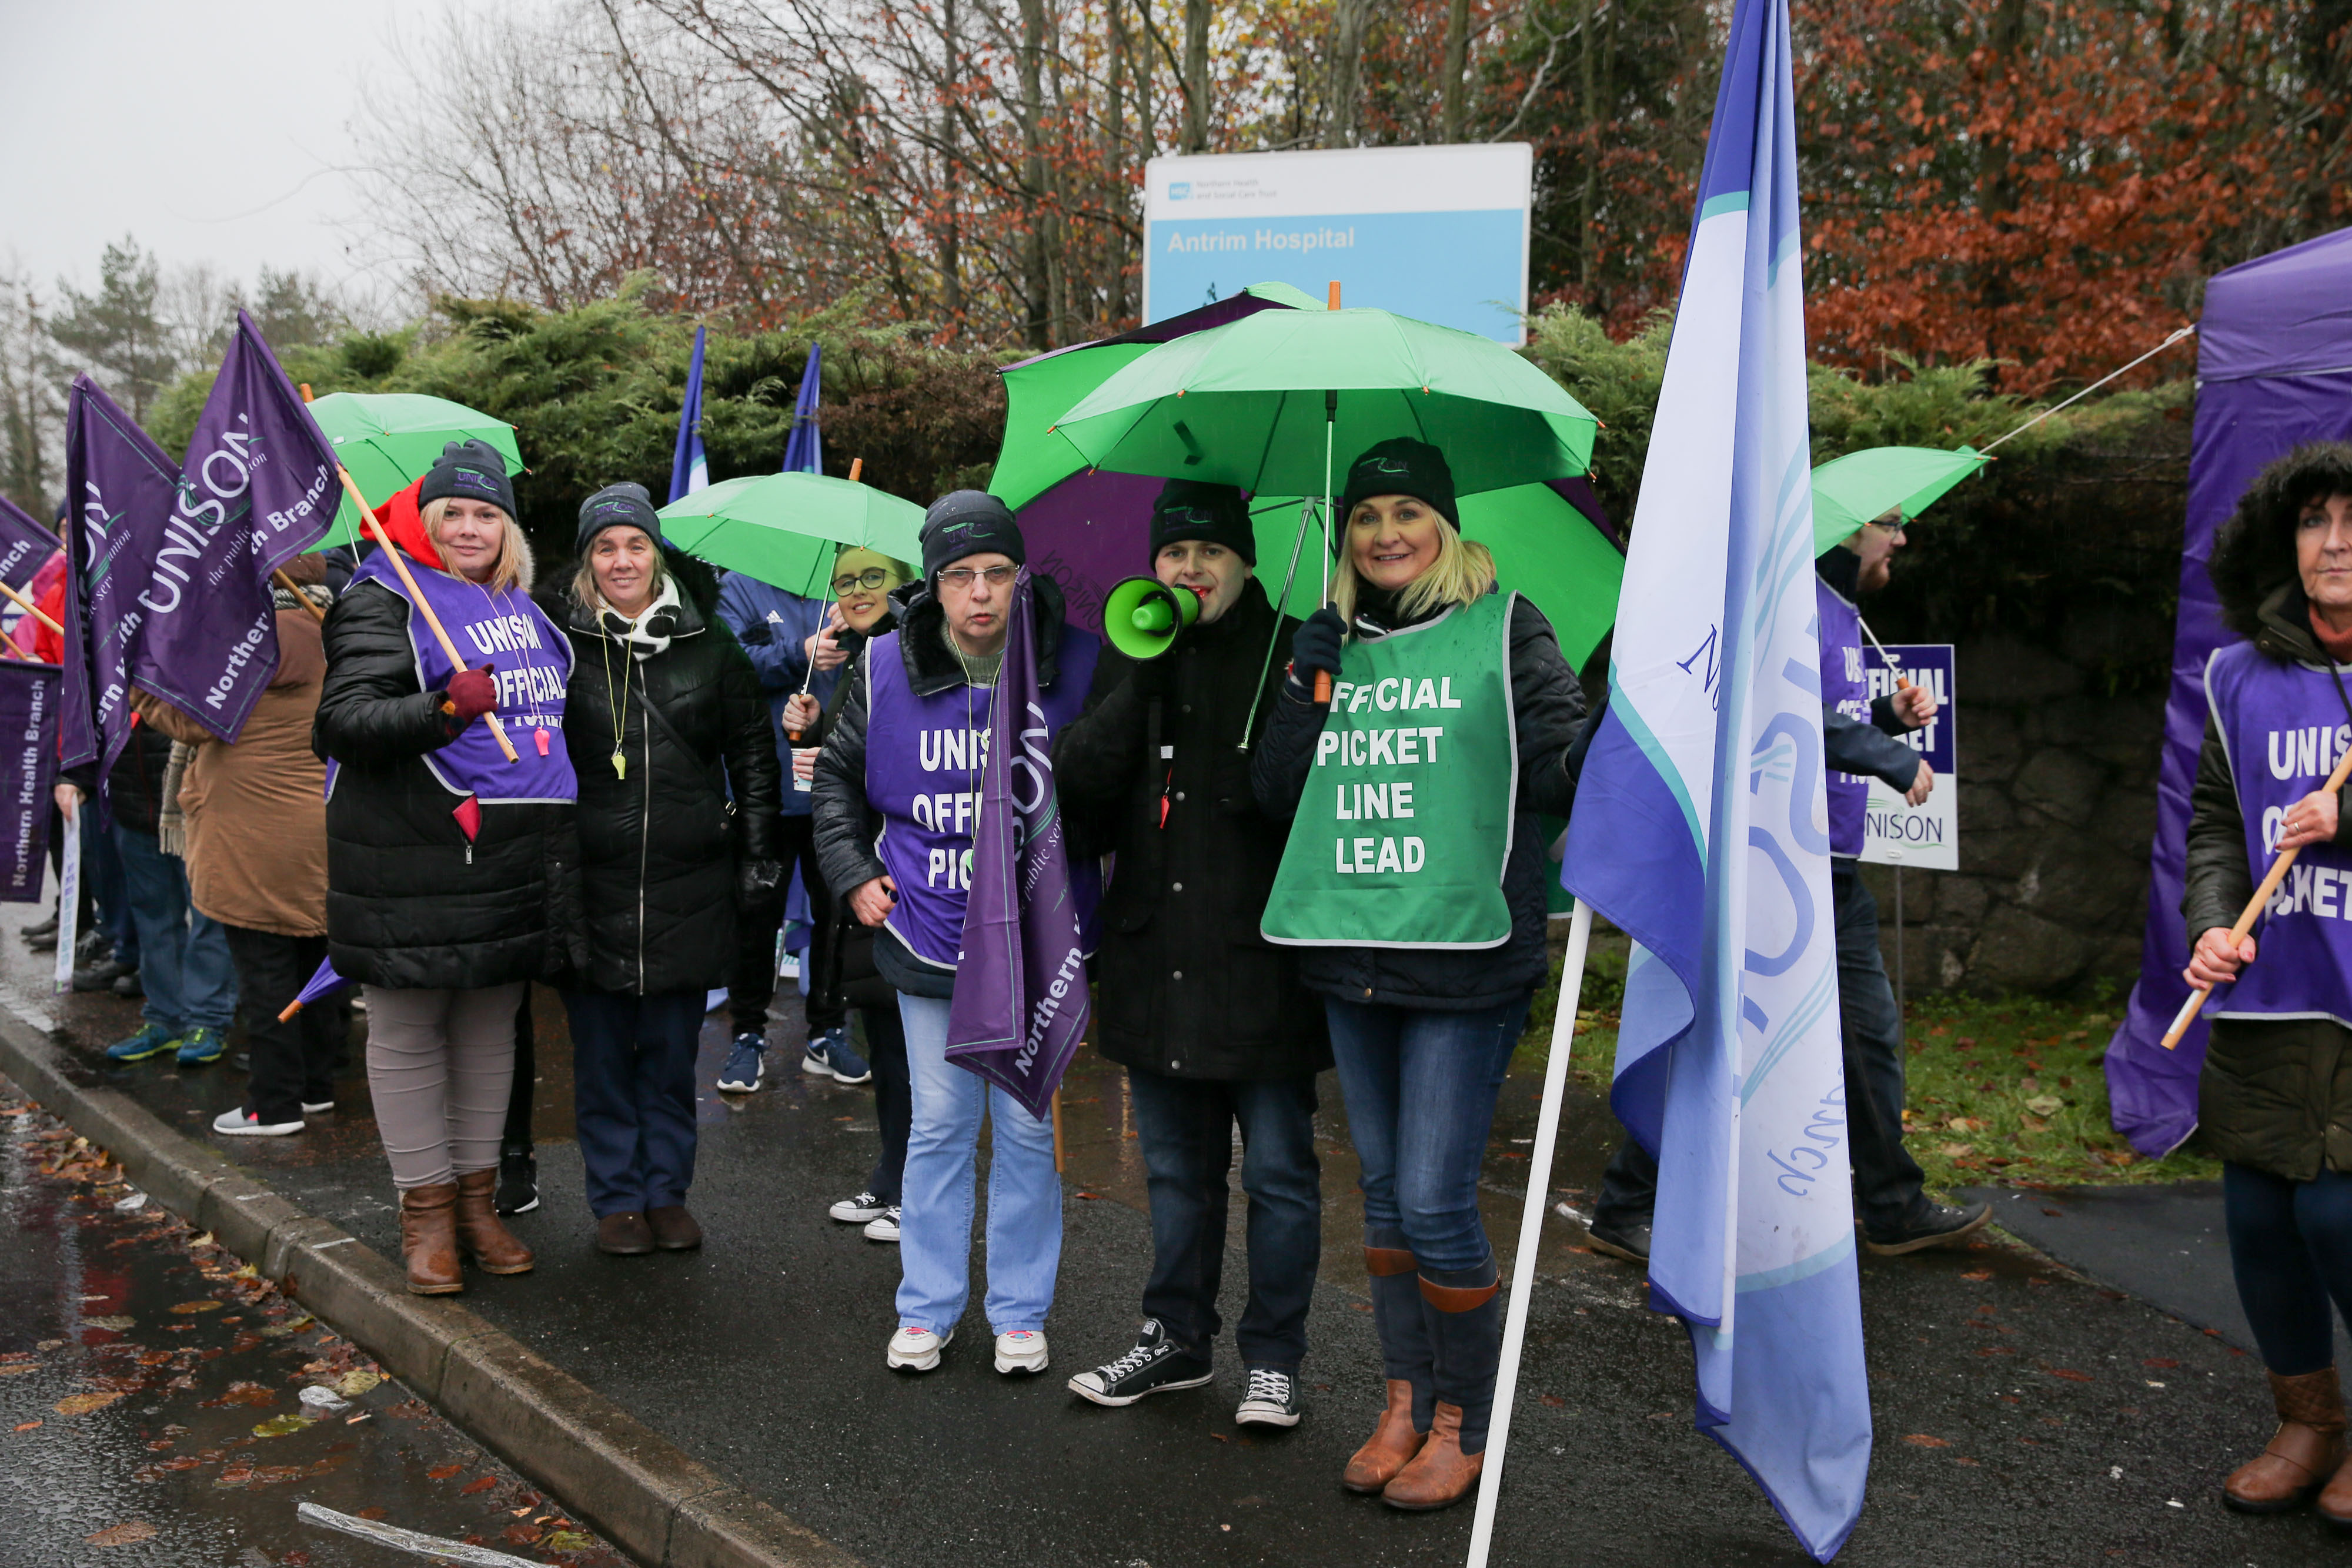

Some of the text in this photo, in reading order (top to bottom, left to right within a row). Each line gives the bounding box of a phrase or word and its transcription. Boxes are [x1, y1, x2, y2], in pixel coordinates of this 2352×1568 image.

[1167, 227, 1355, 254] Antrim Hospital
[266, 464, 328, 532] Branch
[465, 613, 543, 655] UNISON
[1329, 677, 1462, 714] FFICIAL
[1317, 727, 1444, 766] PICKET
[12, 680, 45, 886] Northern Health Branch
[1336, 782, 1414, 820] LINE
[1866, 812, 1943, 842] NISON
[1336, 836, 1426, 874] LEAD
[1015, 947, 1083, 1077] Northern
